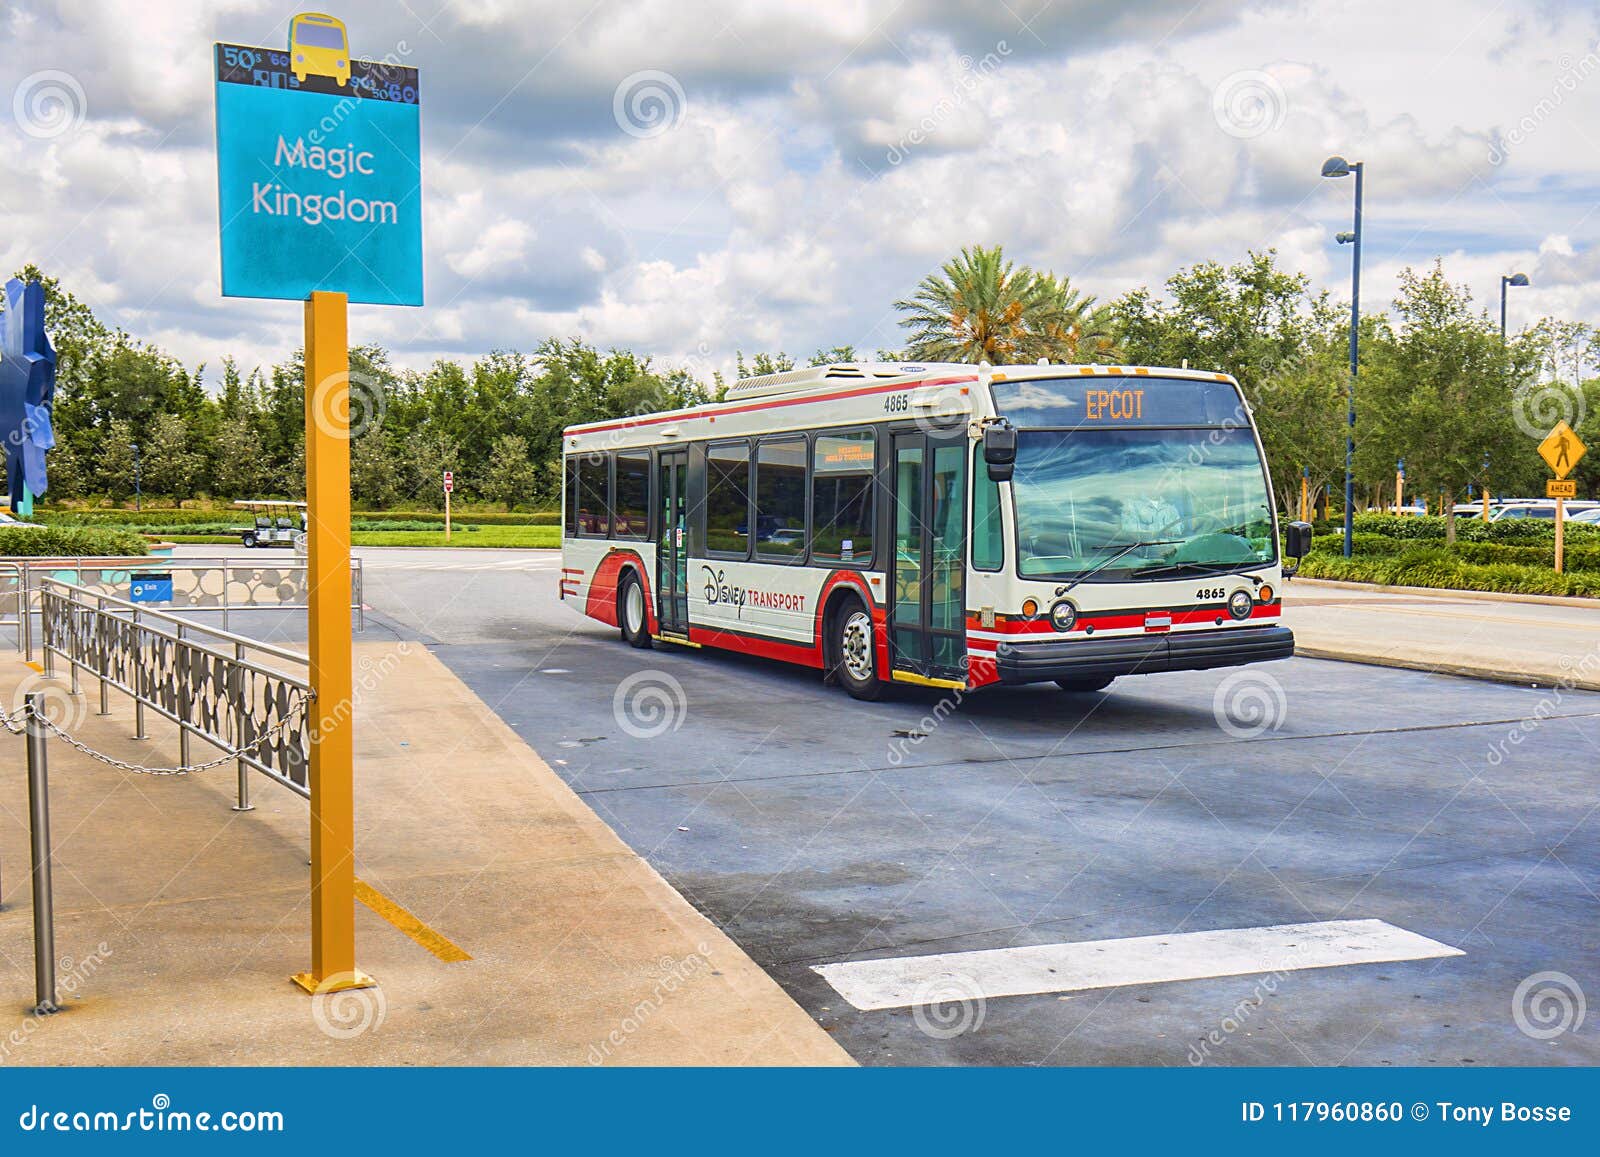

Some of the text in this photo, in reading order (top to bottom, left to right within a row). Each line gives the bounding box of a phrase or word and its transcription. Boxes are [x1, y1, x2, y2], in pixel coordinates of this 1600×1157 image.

[274, 134, 374, 178] Magic
[252, 182, 397, 224] Kingdom
[884, 394, 908, 412] 4865
[1086, 390, 1144, 419] EPCOT
[1551, 484, 1574, 493] AHEAD
[747, 589, 805, 612] TRANSPORT
[1196, 587, 1225, 599] 4865
